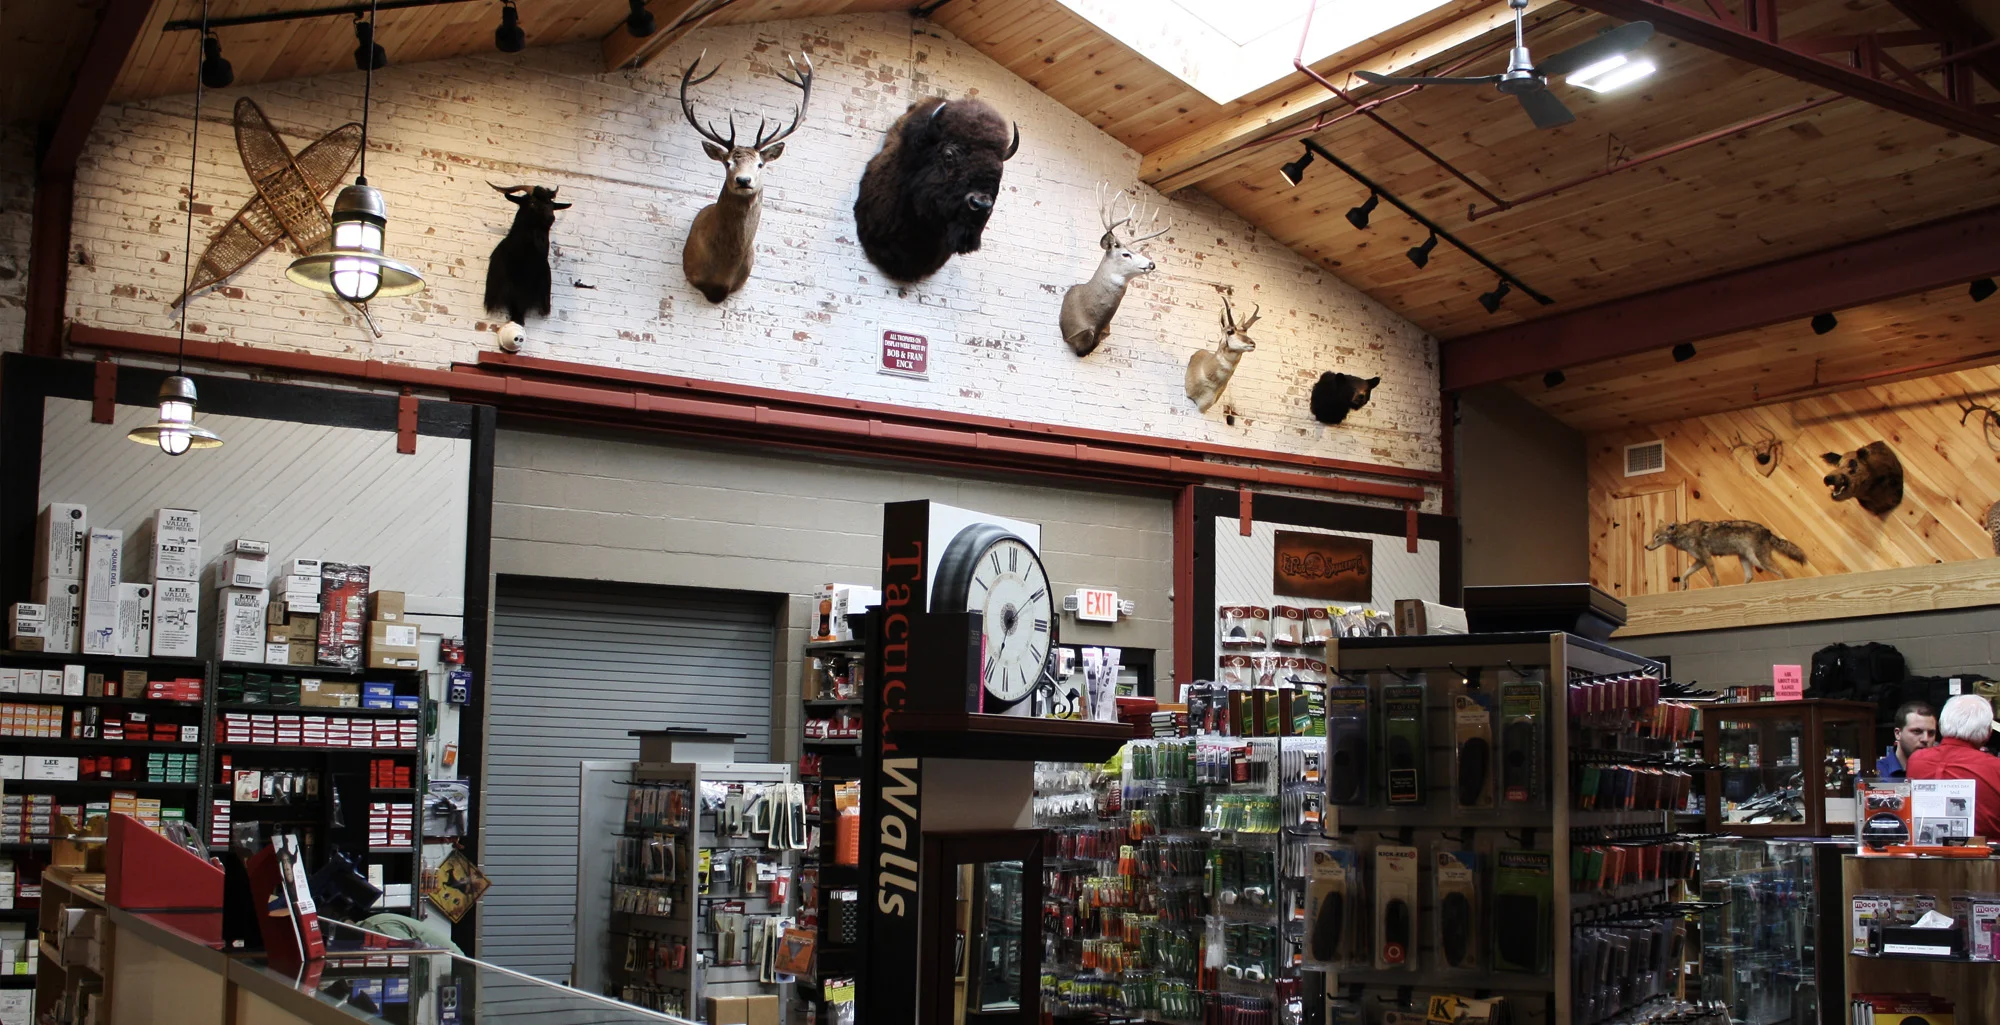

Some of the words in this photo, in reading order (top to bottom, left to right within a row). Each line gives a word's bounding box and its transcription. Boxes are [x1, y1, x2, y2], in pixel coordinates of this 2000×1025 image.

[887, 348, 899, 358] BOB
[901, 351, 906, 359] &
[907, 352, 923, 361] FRAN
[896, 360, 913, 369] ENCK
[166, 520, 191, 528] VALUE
[1086, 591, 1113, 617] EXIT
[71, 606, 79, 627] LEE
[141, 609, 149, 630] LEE
[878, 757, 918, 917] Walls
[1855, 901, 1876, 909] mace
